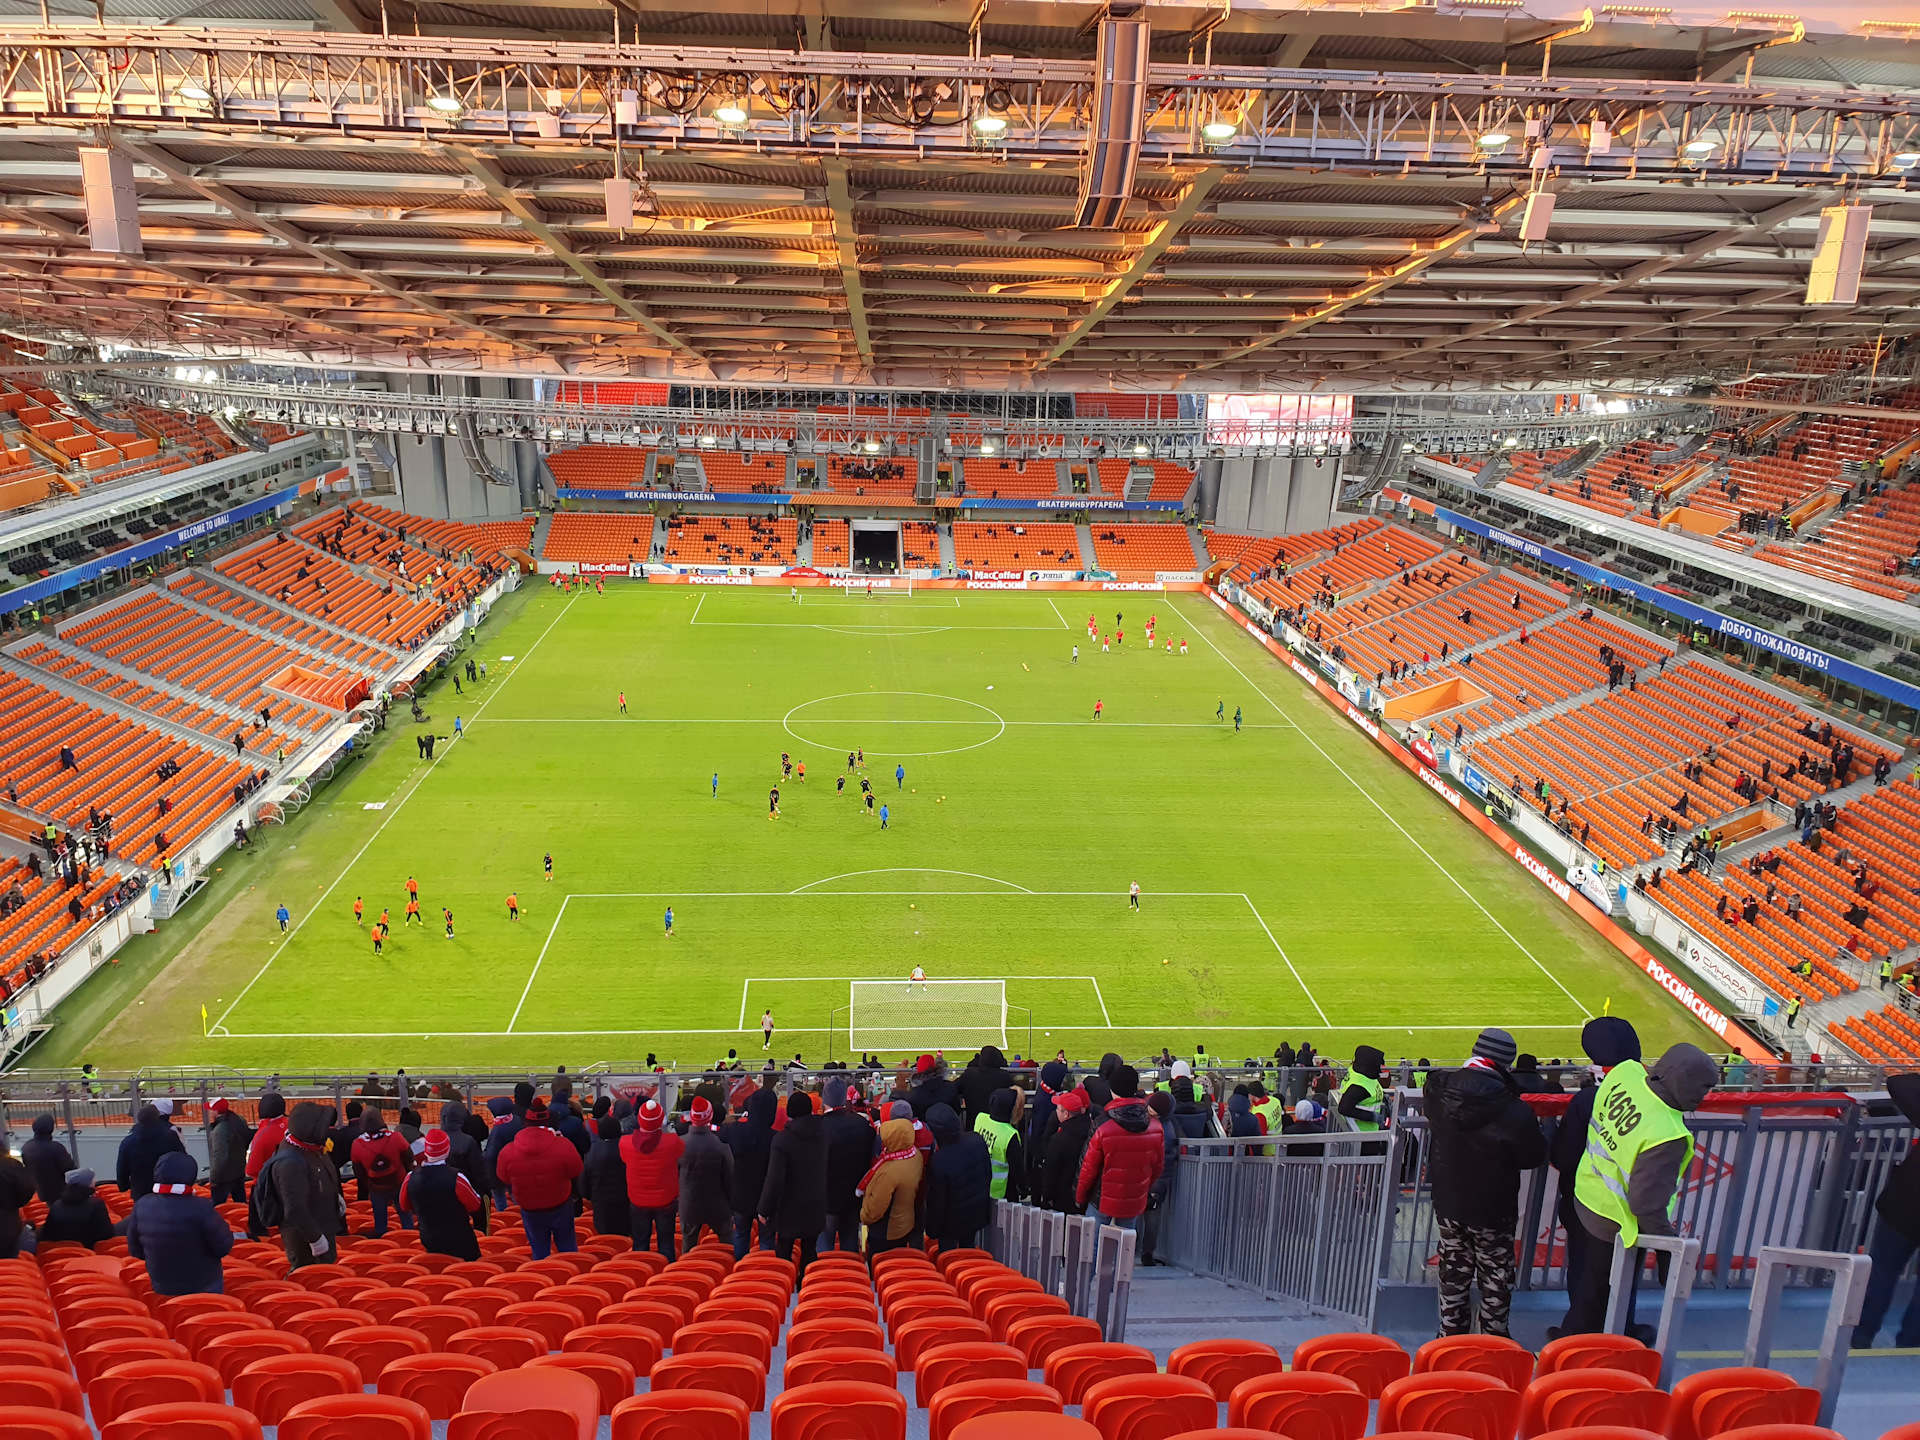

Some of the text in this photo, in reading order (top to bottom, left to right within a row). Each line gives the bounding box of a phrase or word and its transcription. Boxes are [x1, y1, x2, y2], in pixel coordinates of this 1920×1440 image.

[625, 491, 716, 501] #EKATERINBURGARENA
[1037, 500, 1124, 509] #ЕКАТЕРИНБУРГАРЕНА
[178, 514, 229, 541] WELCOME TO URAL!
[1488, 529, 1542, 557] ЕКАТЕРИНБУРГ АРЕНА
[581, 563, 627, 573] MacCoffee
[974, 571, 1022, 580] MacCoffee
[689, 575, 752, 585] РОССИЙСКИЙ
[966, 580, 1028, 589] РОССИЙСКИЙ
[1102, 581, 1164, 591] РОССИЙСКИЙ
[1720, 619, 1830, 670] ДОБРО ПОЖАЛОВАТЬ!
[1419, 767, 1460, 808] РОССИЙСКИЙ
[1515, 847, 1571, 902] РОССИЙСКИЙ
[1703, 956, 1748, 996] СИНАРА
[1647, 958, 1728, 1036] РОССИЙСКИЙ
